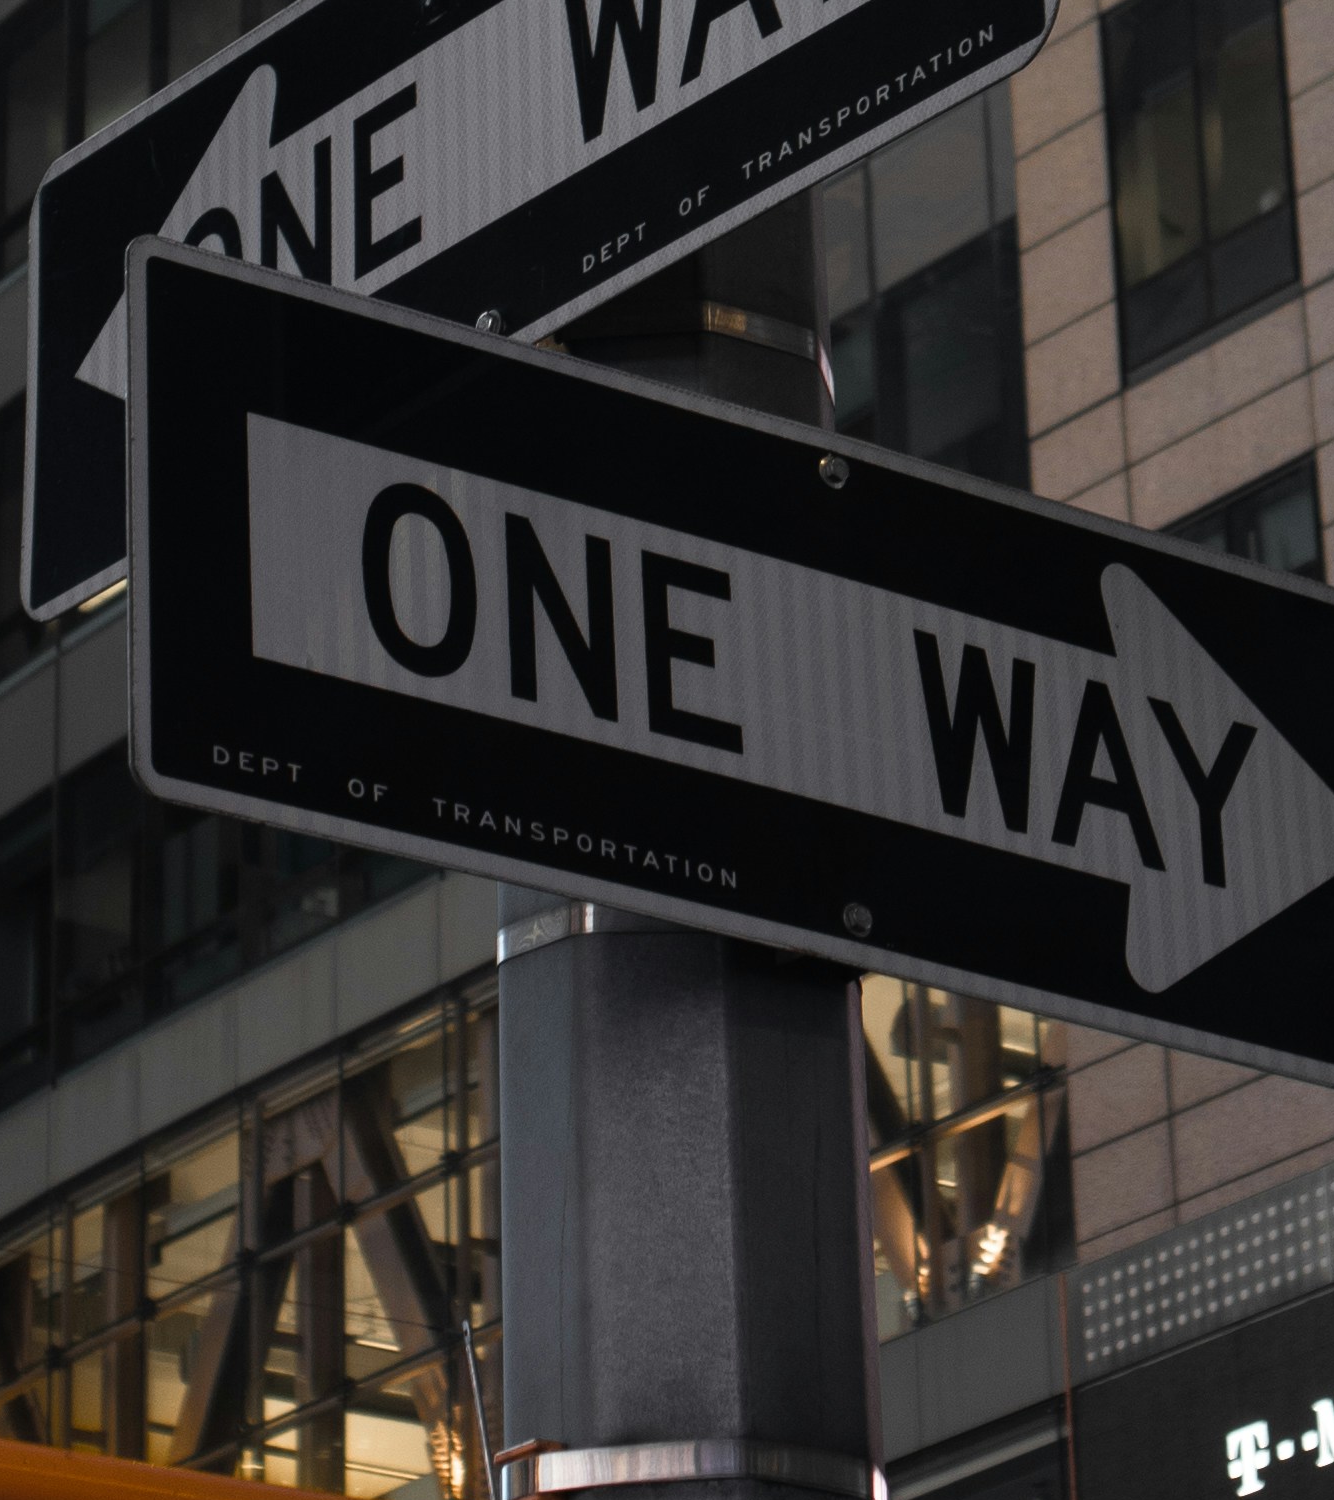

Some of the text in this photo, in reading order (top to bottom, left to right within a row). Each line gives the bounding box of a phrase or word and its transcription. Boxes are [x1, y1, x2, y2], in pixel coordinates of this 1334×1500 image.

[581, 23, 996, 275] DEPT OF TRANSPORTATION
[361, 481, 1258, 890] ONE WAY
[212, 744, 739, 890] DEPT OF TRANSPORTATION
